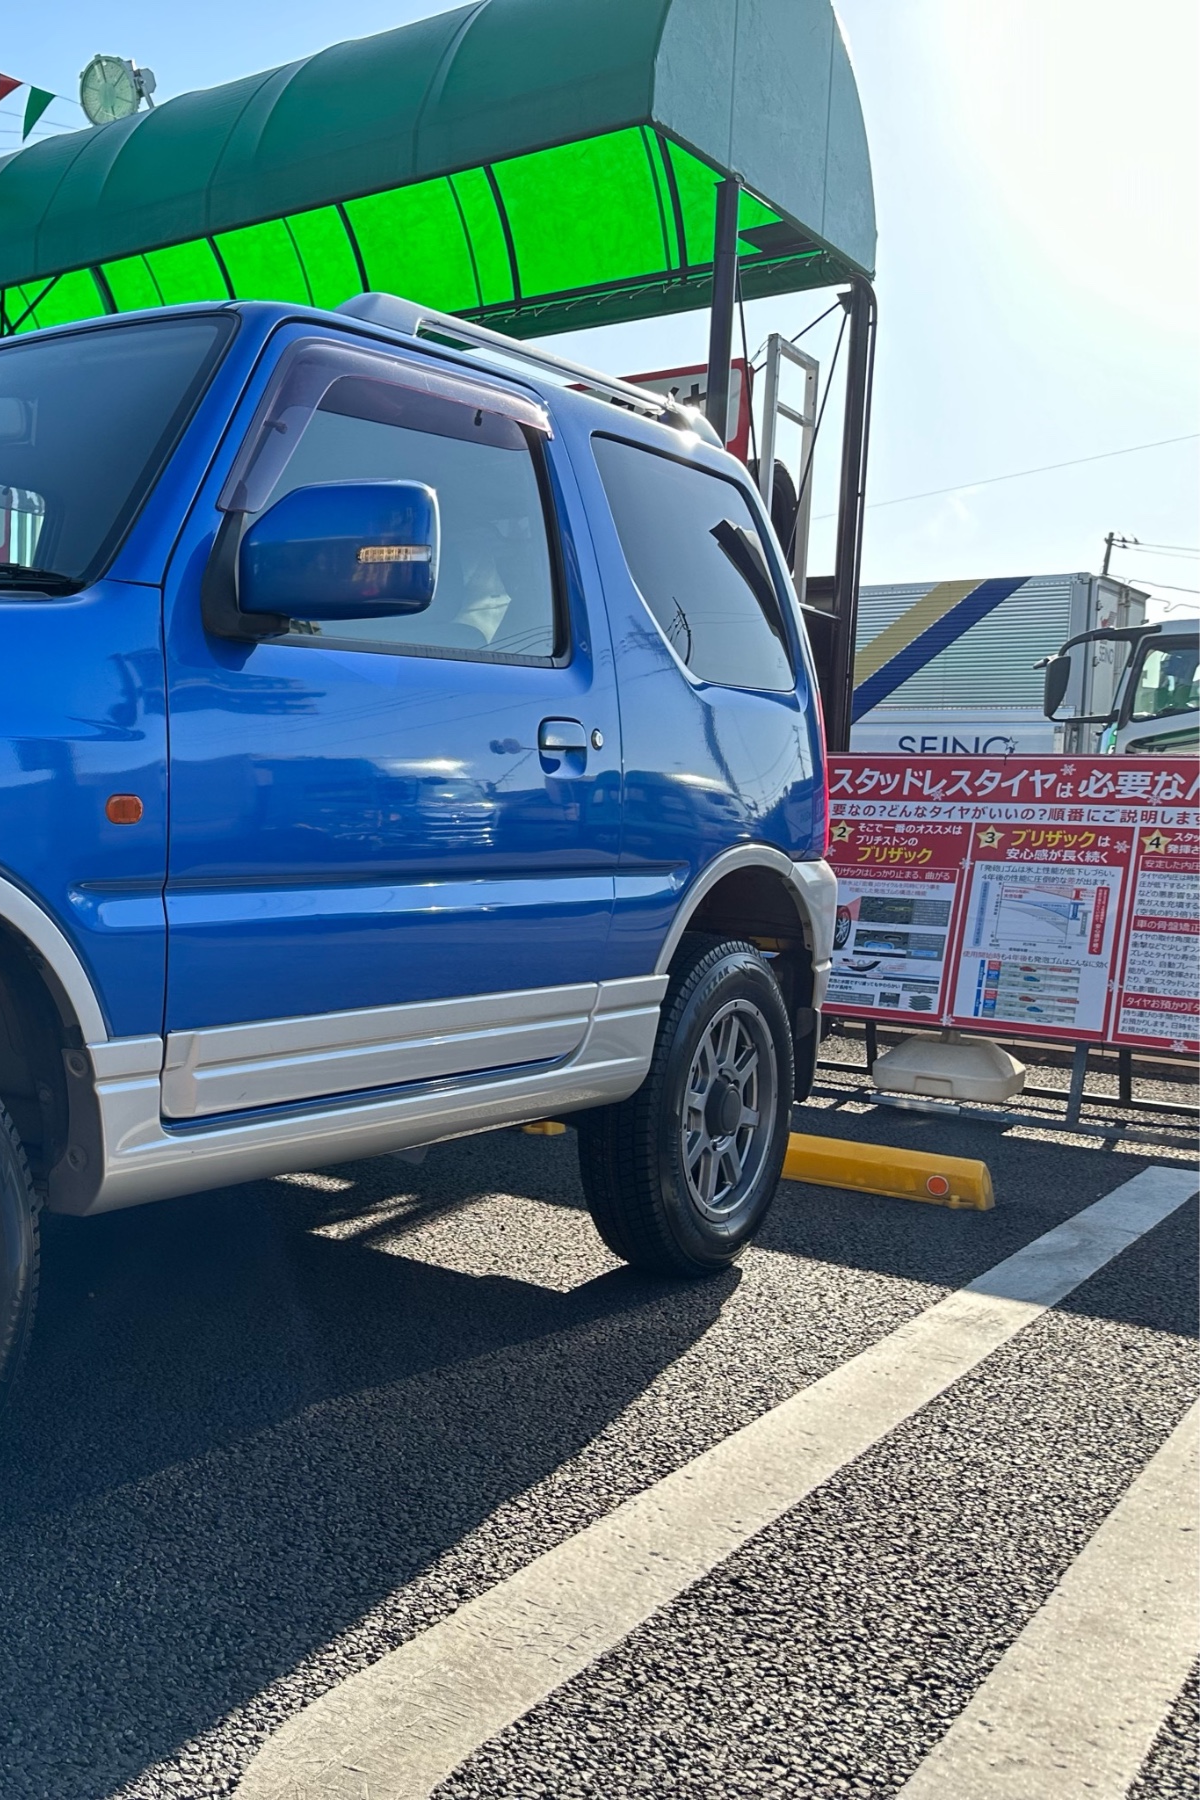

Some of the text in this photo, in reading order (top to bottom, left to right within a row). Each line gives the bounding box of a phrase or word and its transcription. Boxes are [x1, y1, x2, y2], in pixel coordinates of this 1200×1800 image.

[837, 827, 846, 838] 2
[858, 822, 963, 835] そこで一番のオススメは
[985, 832, 995, 843] 3
[1149, 836, 1161, 848] 4
[857, 846, 933, 864] ブリザック
[1006, 848, 1109, 863] 安心感が長く続く
